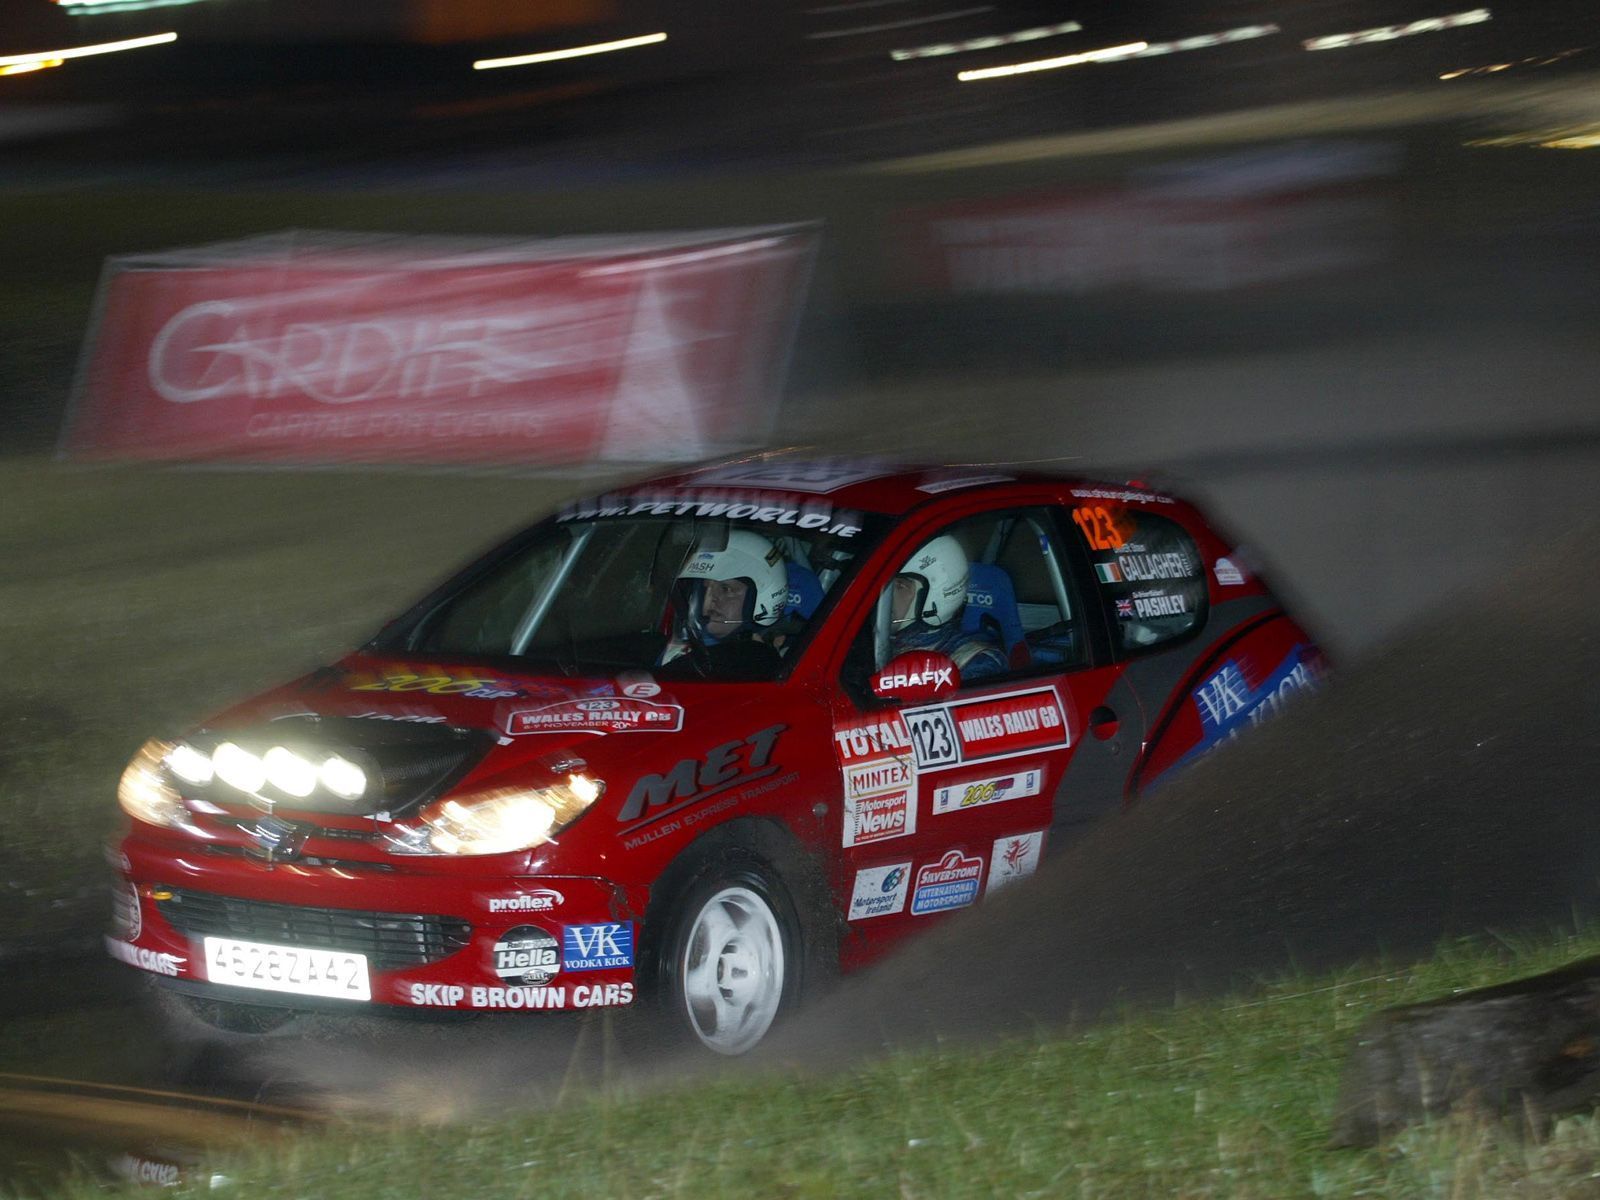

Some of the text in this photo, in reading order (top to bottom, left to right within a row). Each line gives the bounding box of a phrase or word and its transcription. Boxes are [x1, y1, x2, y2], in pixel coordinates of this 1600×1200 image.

[1072, 506, 1122, 551] 123
[1119, 552, 1188, 581] GALLAGHER
[1134, 594, 1186, 618] PASHLEY
[351, 674, 497, 694] 206
[879, 667, 953, 692] GRAFIX
[1197, 667, 1246, 725] VK
[522, 711, 585, 725] WALES
[588, 711, 642, 723] RALLY
[543, 721, 609, 729] NOVEMBER
[959, 705, 1060, 742] WALES RALLY GB
[835, 720, 913, 759] TOTAL
[911, 717, 953, 761] 123
[616, 723, 788, 822] MET
[853, 765, 909, 792] MINTEX
[863, 793, 906, 812] Motorsport
[960, 781, 997, 808] 206
[624, 771, 800, 851] MULLEN EXPRESS TRANSPORT
[858, 809, 905, 835] News
[920, 865, 979, 884] SILVERSTONE
[854, 892, 898, 907] Motorsport
[916, 892, 972, 910] MOTORSPORTS
[918, 880, 974, 898] INTERNATIONAL
[489, 895, 554, 912] proflex
[569, 924, 625, 958] VK
[498, 948, 557, 968] Hella
[565, 956, 630, 969] VODKA KICK
[411, 982, 634, 1008] SKIP BROWN CARS
